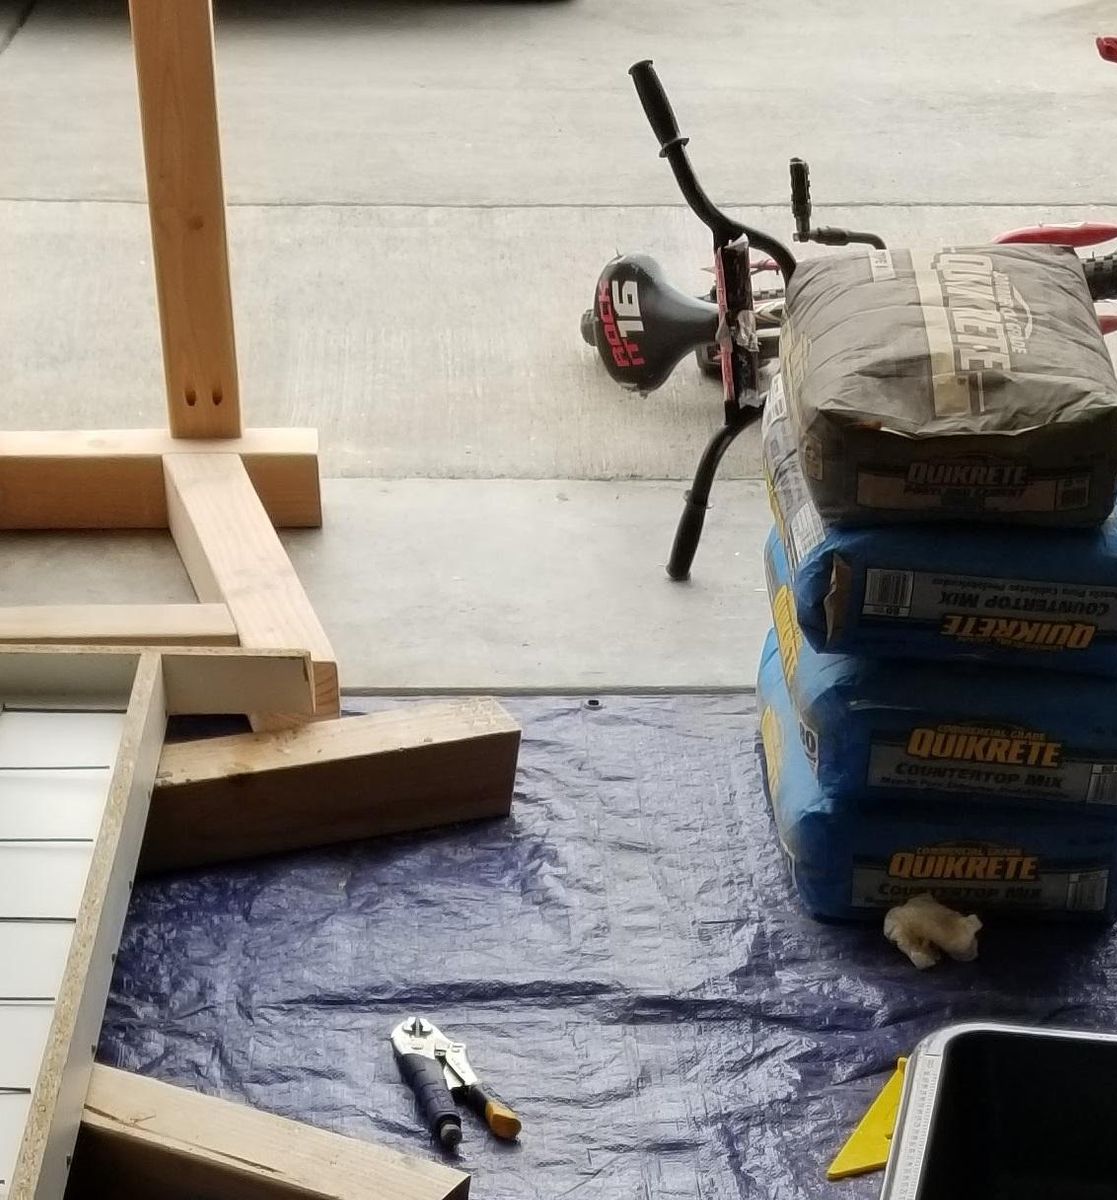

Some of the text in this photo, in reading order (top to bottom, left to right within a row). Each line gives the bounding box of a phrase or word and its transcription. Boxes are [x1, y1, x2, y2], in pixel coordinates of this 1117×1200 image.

[598, 278, 630, 367] ROCK
[612, 281, 645, 337] 16
[935, 254, 1011, 371] QUIKRETE
[907, 463, 1027, 485] QUIKRETE
[940, 591, 1110, 615] COUNTERTOP MIX
[941, 615, 1097, 649] QUIKRETE
[907, 728, 1062, 767] QUIKRETE
[895, 763, 1020, 785] COUNTERTOP
[1024, 774, 1064, 788] MIX
[888, 852, 1039, 880] QUIKRETE
